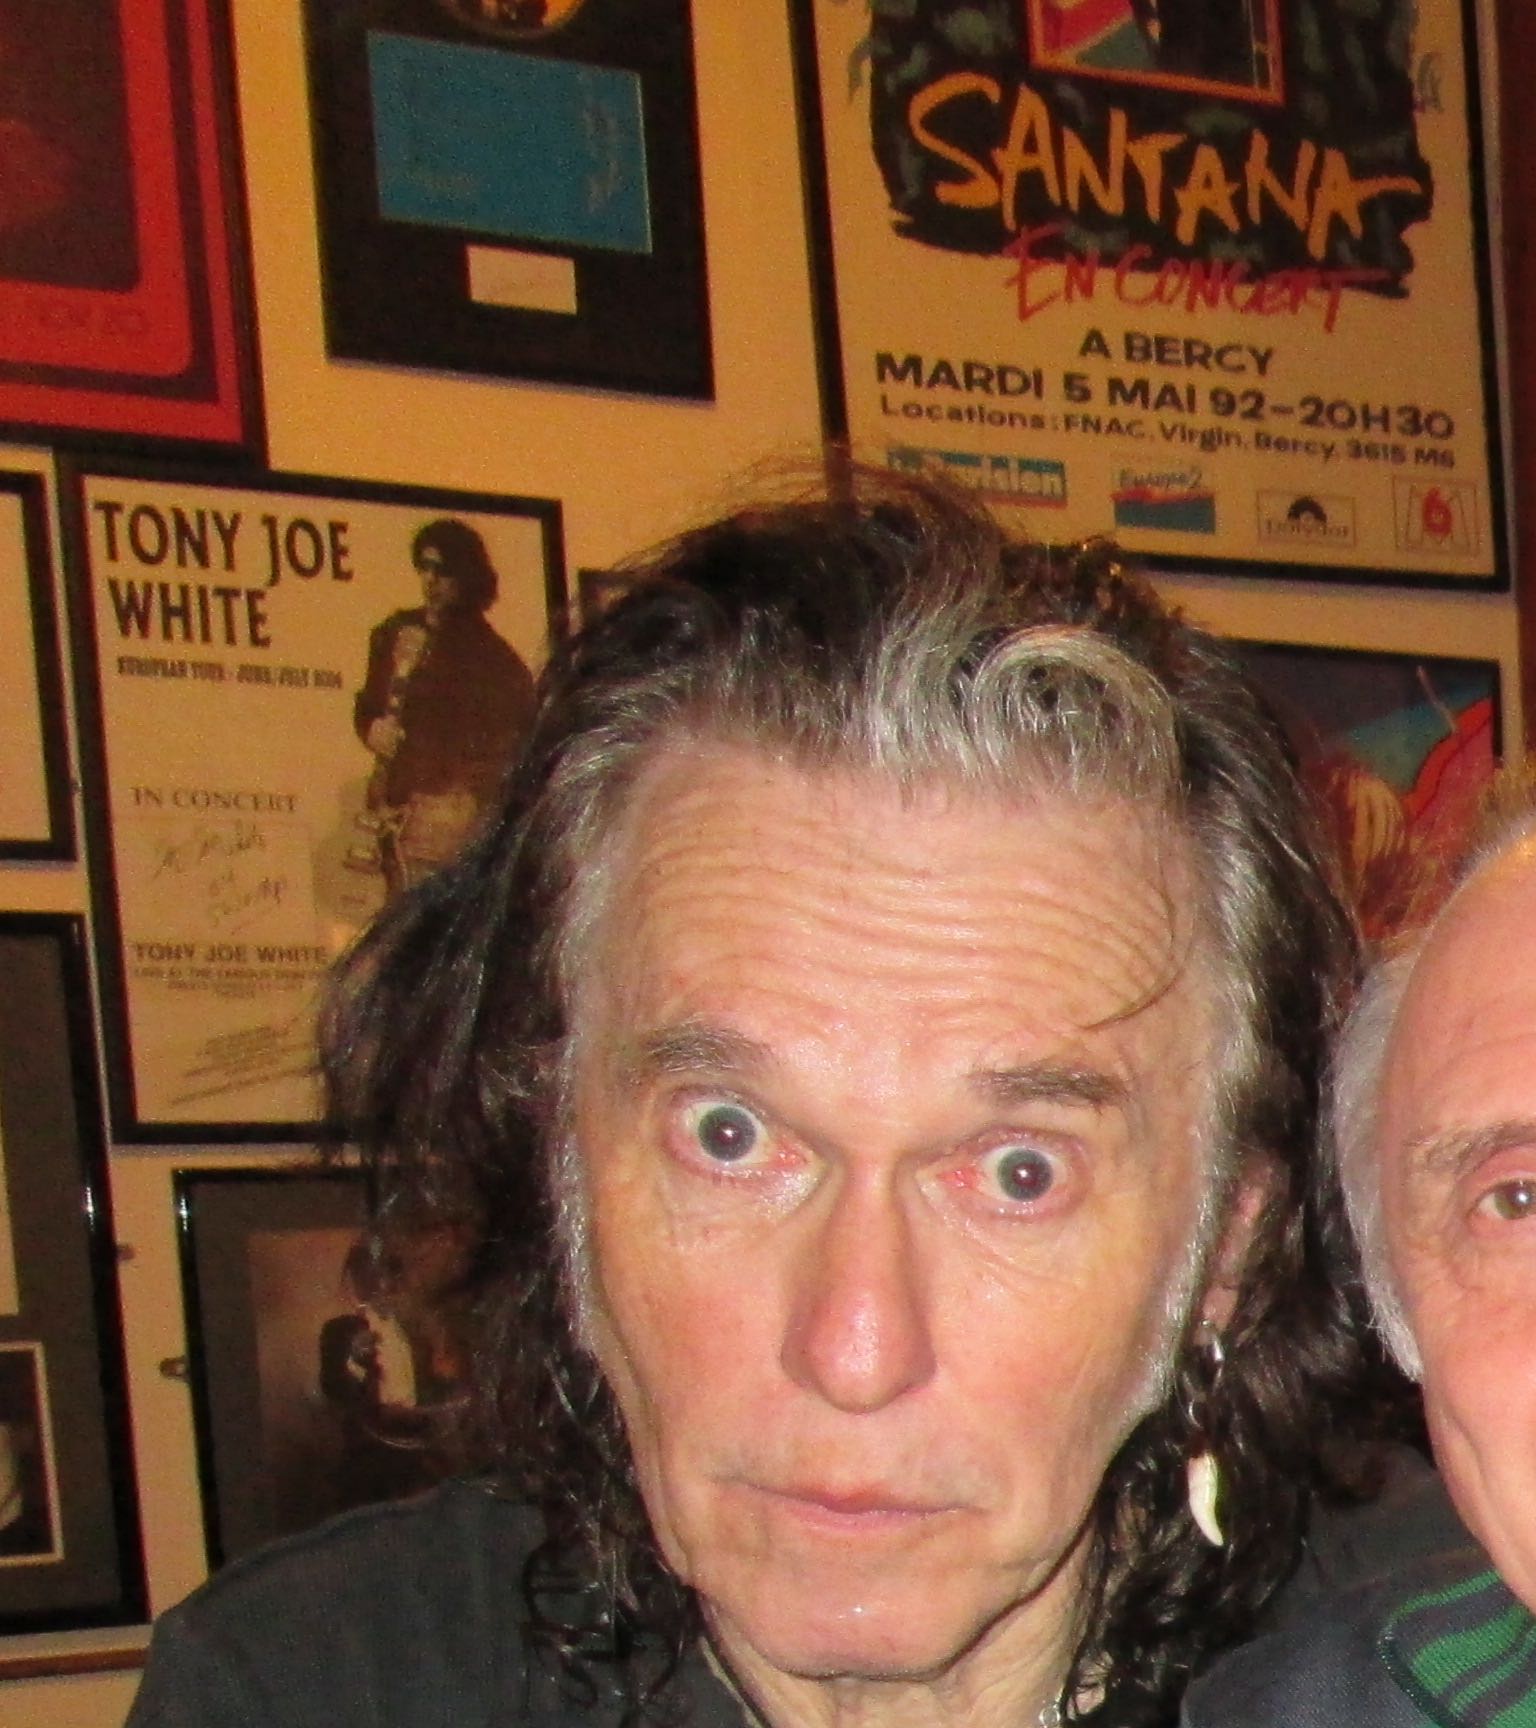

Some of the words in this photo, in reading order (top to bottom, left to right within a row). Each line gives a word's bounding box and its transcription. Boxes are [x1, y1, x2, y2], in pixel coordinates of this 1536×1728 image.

[907, 71, 1422, 260] SANTANA
[875, 352, 1044, 399] MARDI
[1063, 371, 1092, 403] 5
[1107, 377, 1197, 414] MAI
[1079, 328, 1111, 358] A
[1124, 331, 1274, 376] BERCY
[94, 499, 243, 573] TONY
[261, 512, 354, 587] JOE
[107, 576, 272, 648] WHITE
[129, 786, 163, 808] IN
[172, 788, 296, 812] CONCERT
[136, 943, 196, 961] TONY
[205, 944, 249, 963] JOE
[257, 944, 328, 964] WHITE
